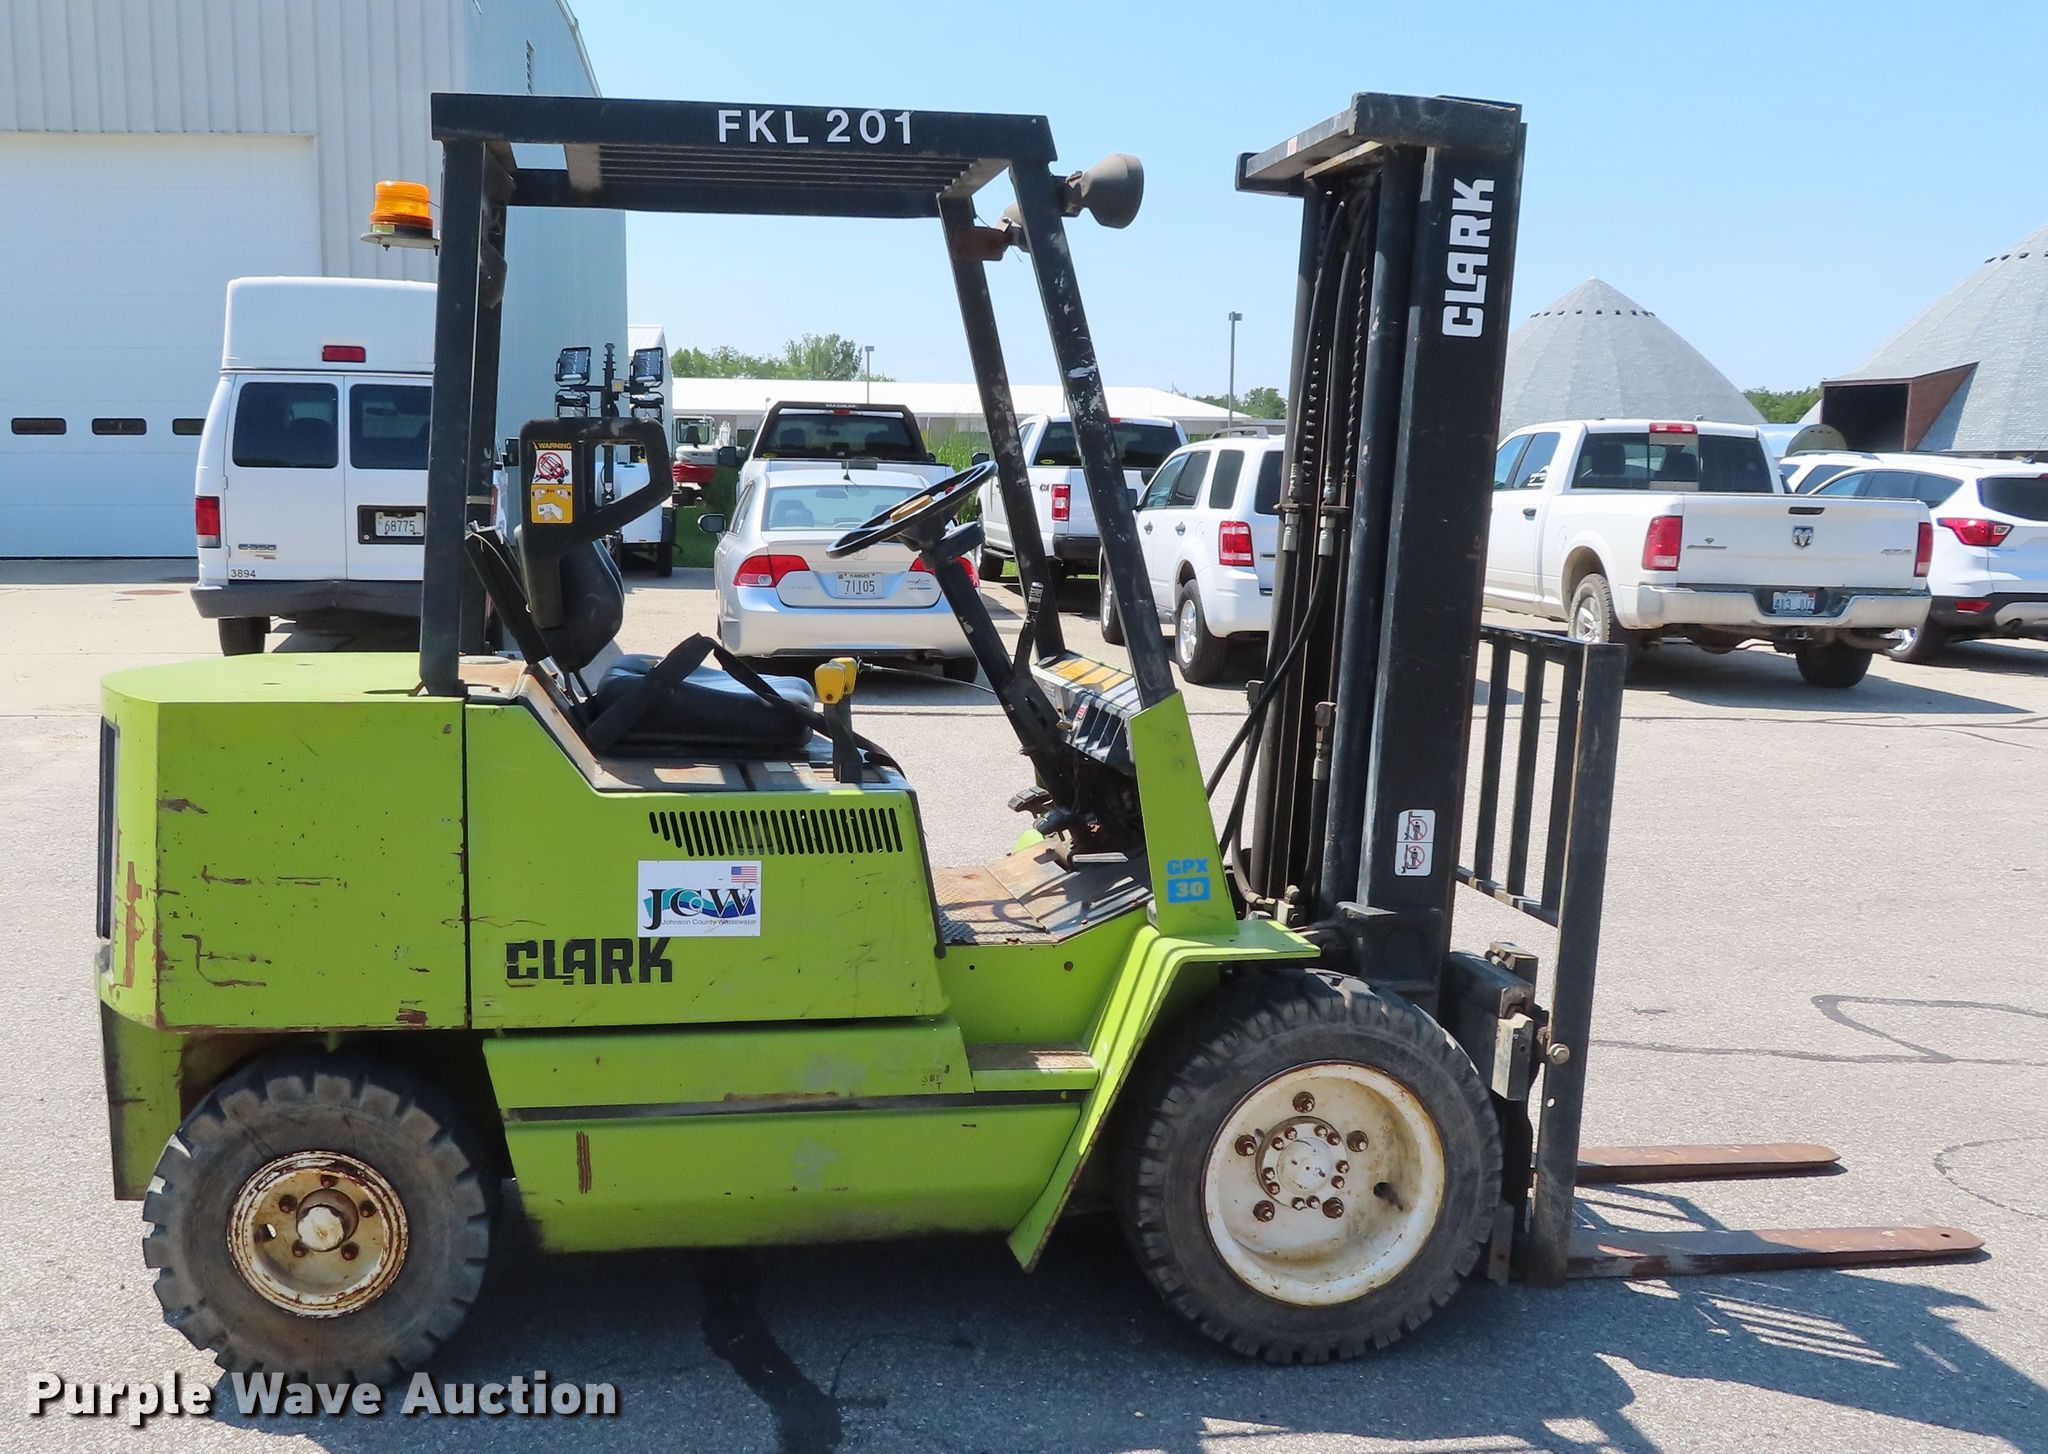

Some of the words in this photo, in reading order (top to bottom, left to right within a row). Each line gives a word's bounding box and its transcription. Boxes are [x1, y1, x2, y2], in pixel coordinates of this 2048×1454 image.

[717, 109, 809, 144] FKL
[826, 109, 911, 145] 201
[1441, 177, 1495, 338] CLARK
[384, 519, 416, 533] 68775
[230, 569, 257, 578] 3894
[845, 580, 875, 593] 71105
[1166, 857, 1209, 876] GPX
[1175, 881, 1205, 898] 30
[643, 888, 756, 930] JCW
[662, 918, 691, 926] Johnson
[692, 918, 717, 927] County
[505, 936, 673, 986] CLARK
